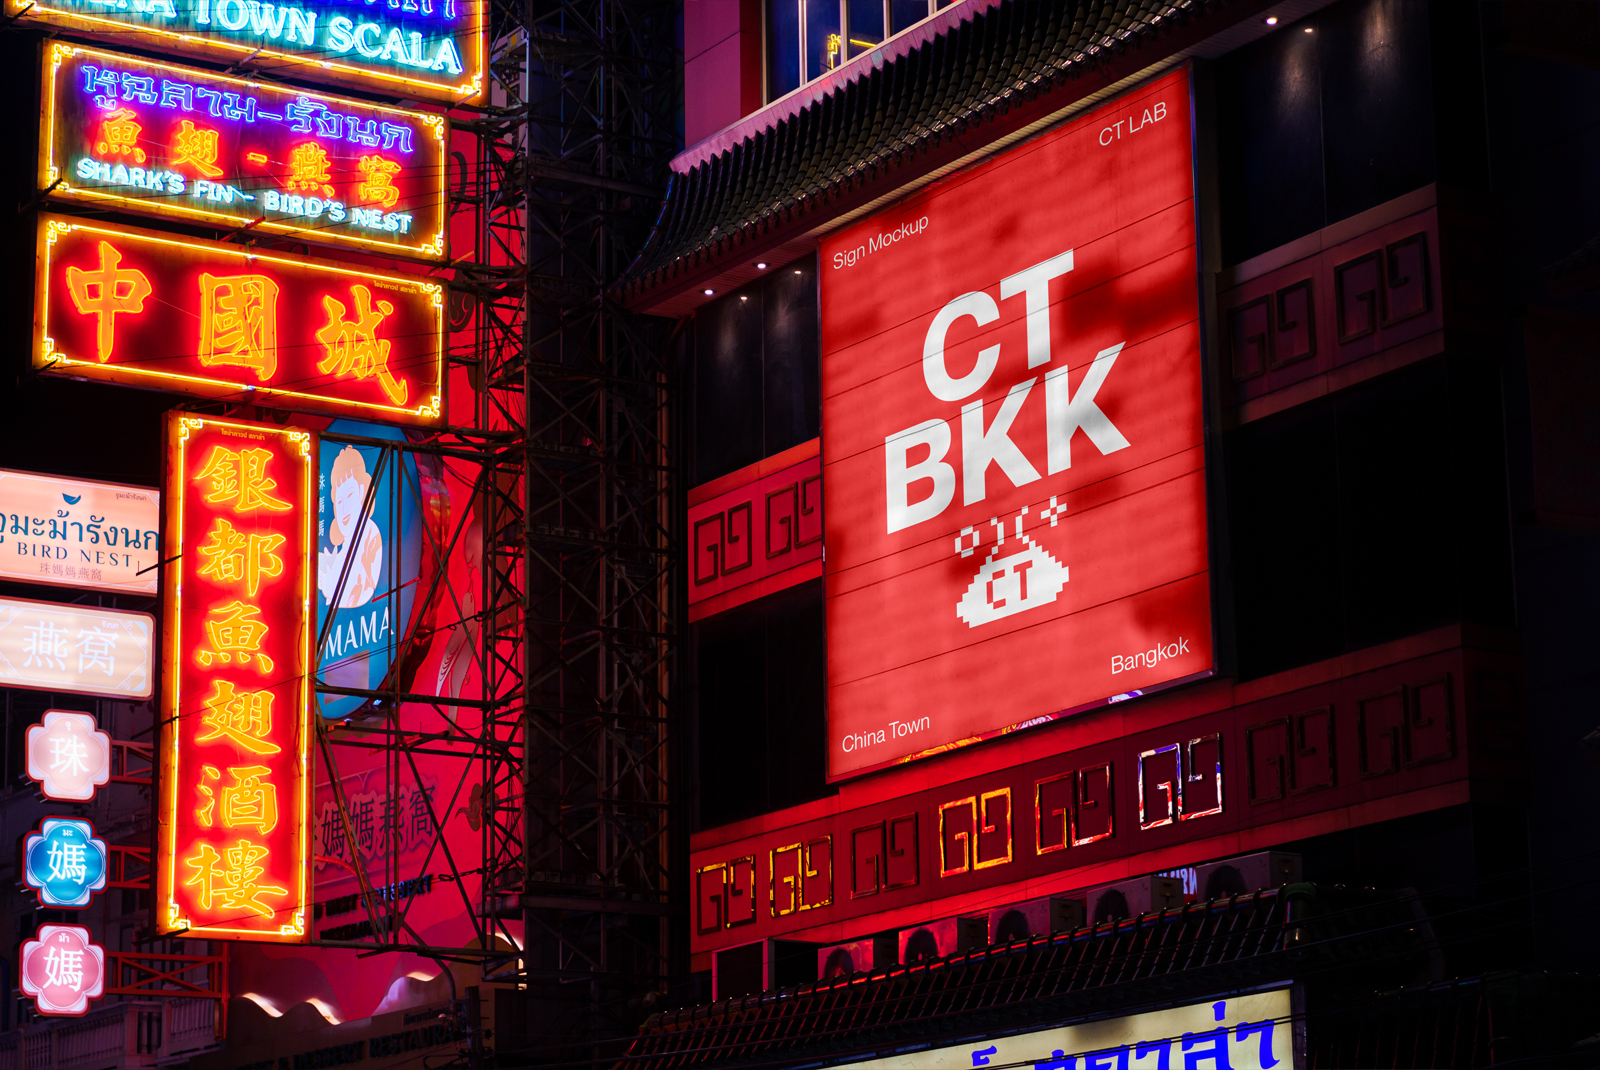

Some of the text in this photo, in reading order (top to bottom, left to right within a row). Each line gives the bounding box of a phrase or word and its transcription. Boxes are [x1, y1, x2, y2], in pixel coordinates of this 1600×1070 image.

[327, 16, 464, 75] SCALA
[1099, 101, 1167, 146] CT LAB
[76, 157, 186, 195] SHARK'S
[264, 190, 347, 222] BIRD'S
[351, 207, 413, 234] NEST
[833, 215, 929, 269] Sign Mockup
[66, 241, 409, 406] 中國城
[922, 249, 1074, 402] CT
[885, 341, 1131, 535] BKK
[17, 541, 133, 567] BIRD NEST
[325, 606, 394, 660] MAMA
[1110, 636, 1190, 675] Bangkok
[183, 445, 294, 920] 銀都魚翅酒樓
[49, 734, 90, 777] 珠
[842, 715, 930, 753] China Town
[314, 784, 436, 861] 媽媽燕窩
[46, 840, 88, 885] 媽
[43, 946, 85, 992] 媽
[369, 1022, 467, 1058] RESTAURAN
